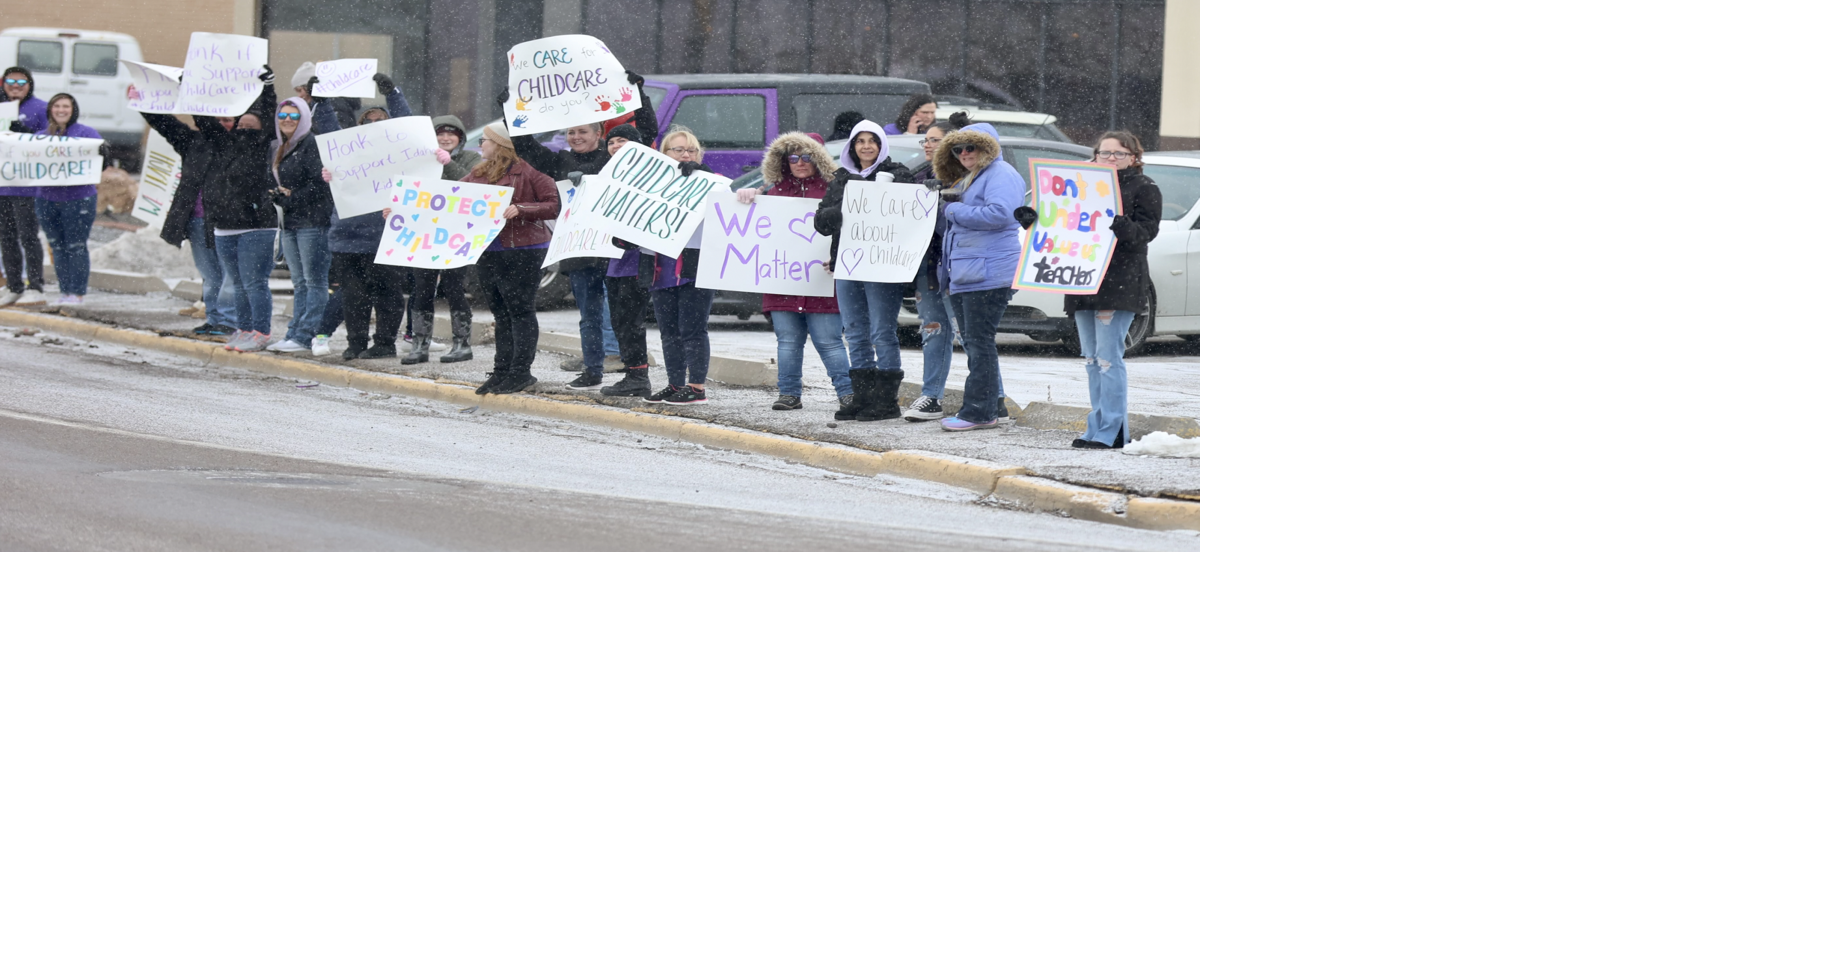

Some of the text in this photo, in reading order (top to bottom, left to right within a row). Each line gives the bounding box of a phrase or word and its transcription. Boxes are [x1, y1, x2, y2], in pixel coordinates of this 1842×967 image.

[533, 47, 573, 69] CARE
[581, 47, 597, 59] for
[517, 67, 608, 103] CHILDCARE
[538, 91, 591, 116] do you?
[385, 129, 408, 143] to
[22, 149, 40, 161] you
[46, 145, 74, 158] CARE
[1, 160, 93, 181] CHILDCARE!
[612, 147, 724, 213] CHILDCARE
[1039, 169, 1088, 201] Dont
[402, 189, 501, 219] PROTECT
[590, 184, 689, 241] MATTERS!
[846, 186, 872, 215] We
[714, 201, 773, 239] We
[850, 219, 898, 244] about
[1038, 200, 1102, 233] Under
[389, 214, 500, 257] CHILDCARE
[719, 242, 825, 286] Matter
